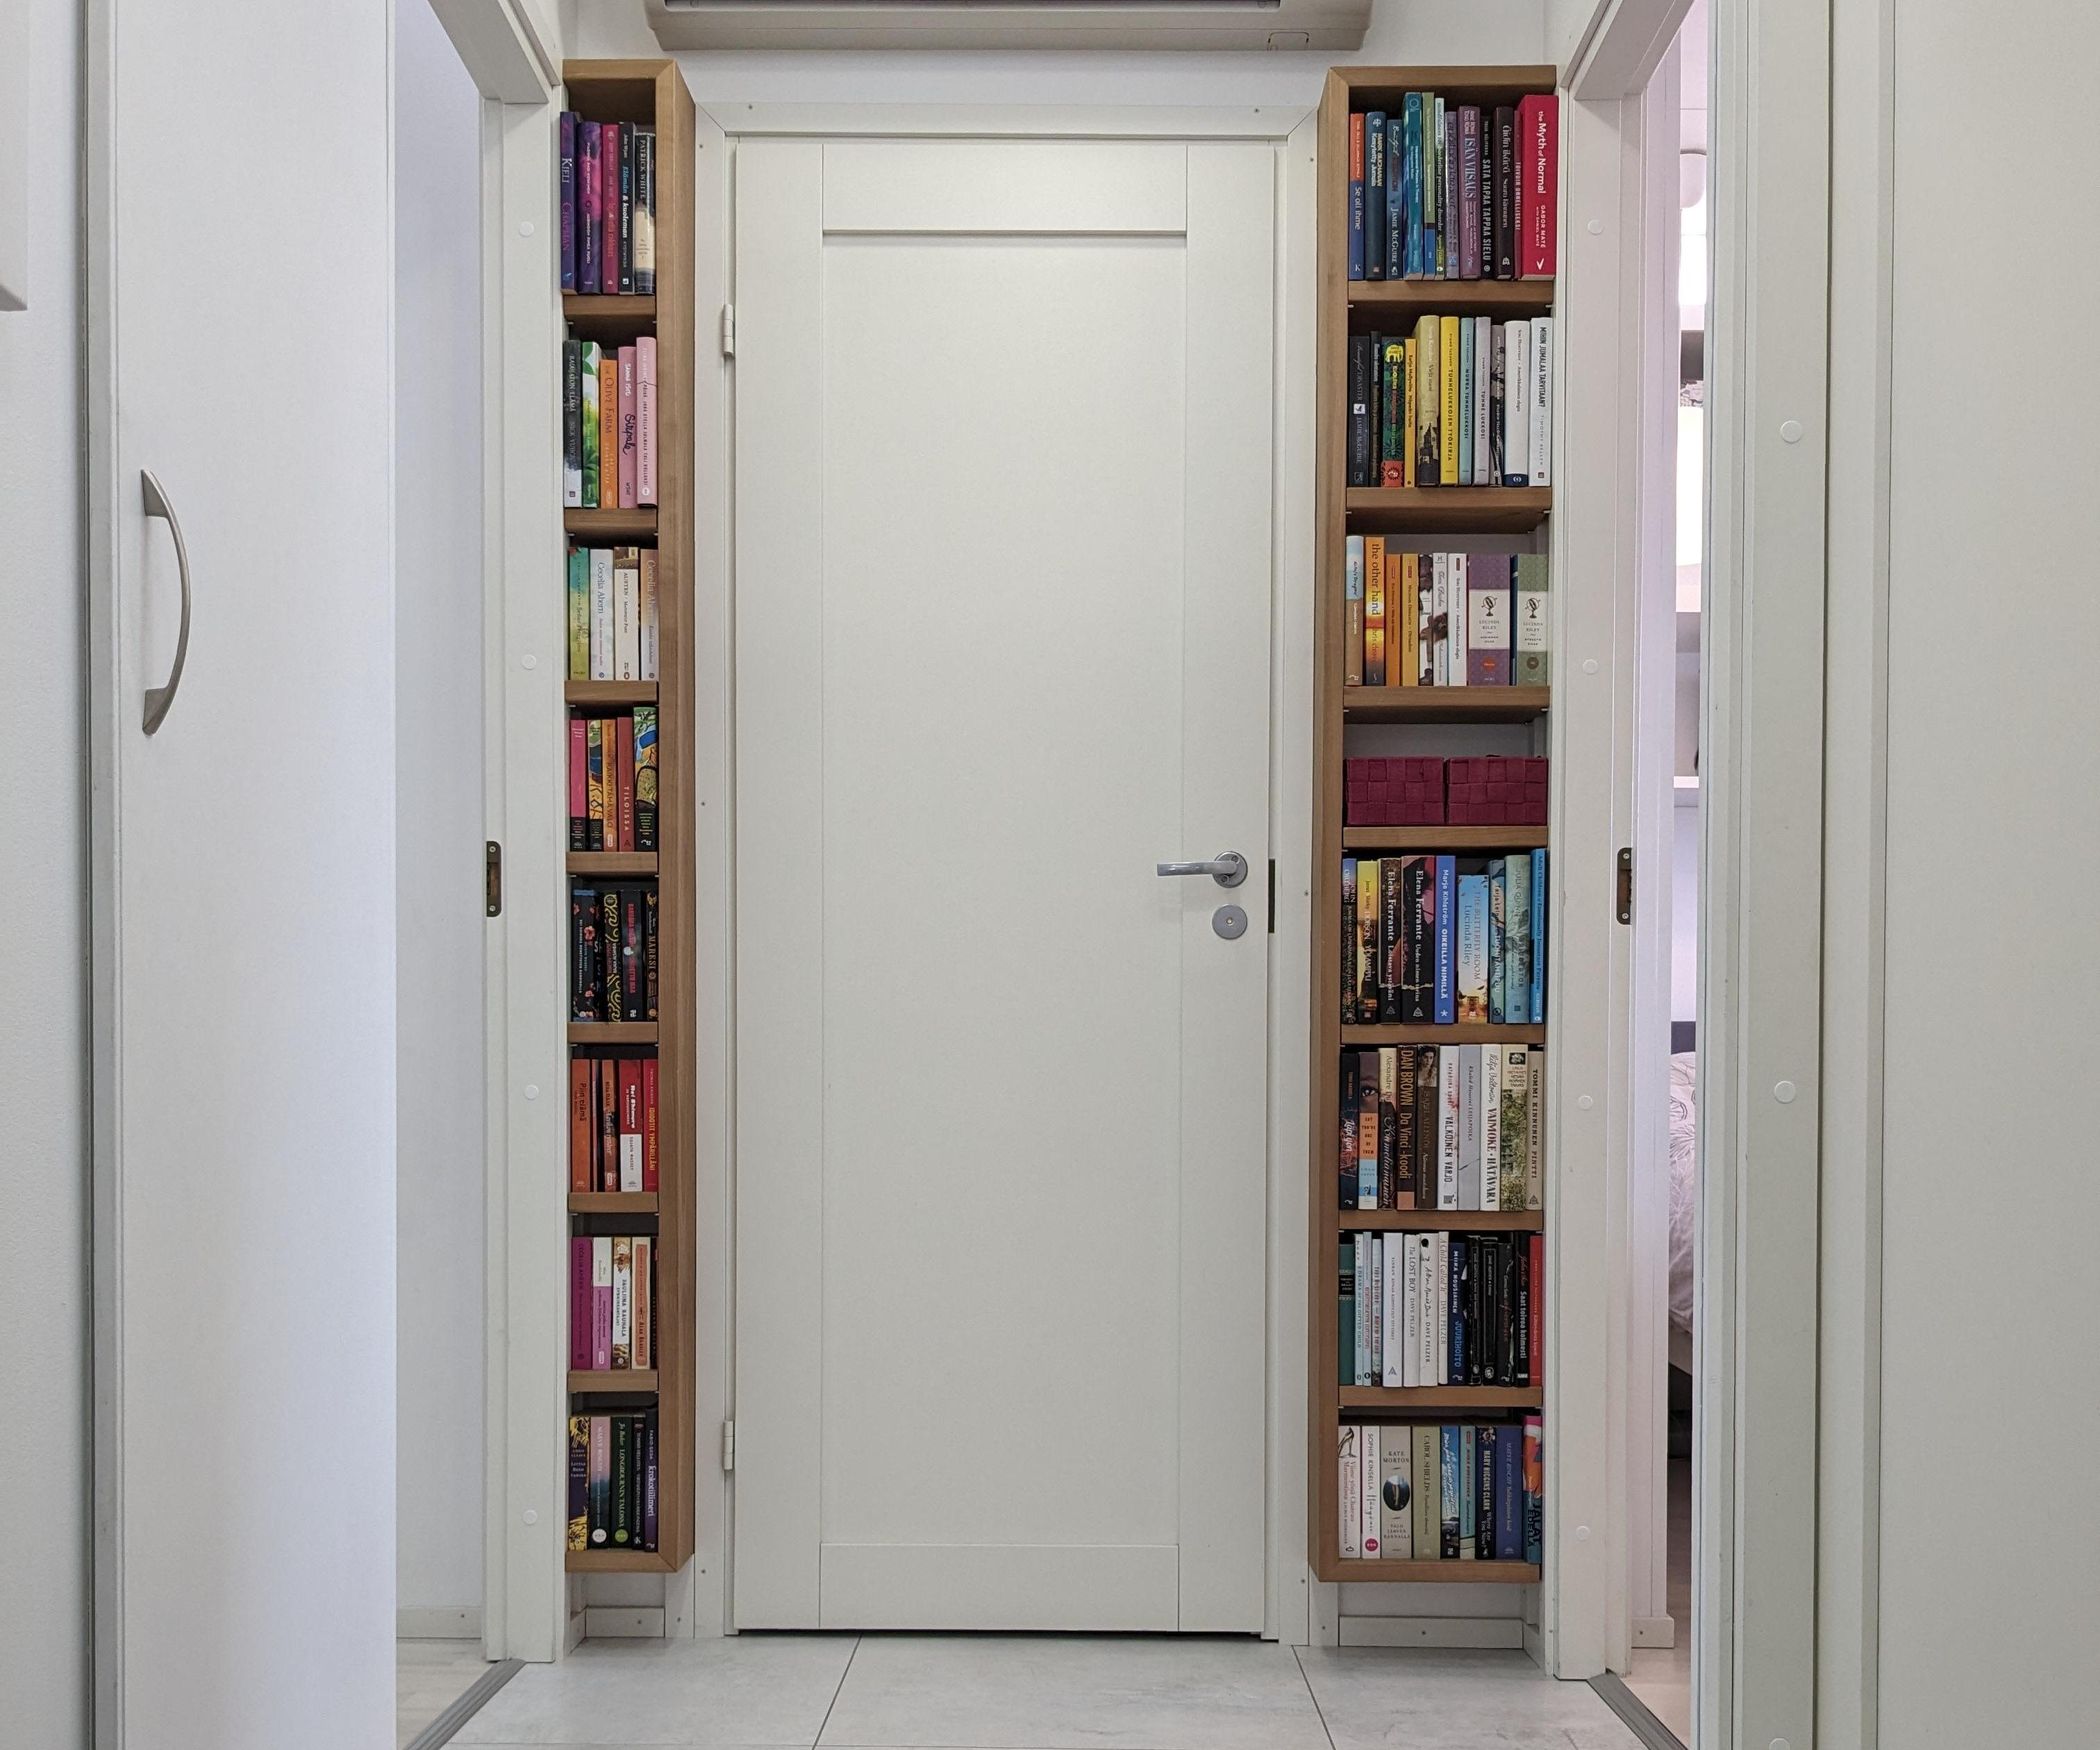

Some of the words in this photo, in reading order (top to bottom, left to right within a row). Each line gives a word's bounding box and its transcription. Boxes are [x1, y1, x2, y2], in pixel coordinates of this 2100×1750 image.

[1536, 122, 1547, 149] Myth
[639, 139, 648, 171] PATRICK
[1464, 137, 1479, 161] ISÄN
[1464, 161, 1476, 199] VIISAUS
[1482, 159, 1491, 179] SATA
[1537, 158, 1547, 194] Normal
[1354, 186, 1362, 197] Se
[1436, 175, 1444, 206] personality
[1482, 181, 1491, 205] TAPAA
[1482, 207, 1491, 236] TAPPAA
[1483, 238, 1491, 261] SIELU
[1538, 374, 1546, 407] TARVITAAN?
[622, 413, 636, 455] Sirpale
[1371, 543, 1381, 560] the
[597, 562, 605, 589] Cecelia
[1371, 561, 1381, 587] other
[597, 591, 605, 614] Ahern
[1371, 590, 1381, 616] hand
[1386, 871, 1395, 896] Elena
[1415, 870, 1424, 895] Elena
[1387, 899, 1396, 941] Ferrante
[1415, 898, 1424, 940] Ferrante
[1463, 905, 1472, 942] Lucinda
[1473, 909, 1481, 952] BUTTERFLY
[648, 935, 656, 969] MARESI
[1462, 943, 1472, 967] Riley
[1473, 954, 1481, 980] ROOM
[1441, 966, 1449, 999] NIMILLÄ
[1385, 1055, 1393, 1090] Alexandre
[1400, 1050, 1413, 1069] DAN
[1400, 1071, 1413, 1105] BROWN
[1400, 1113, 1412, 1125] Da
[1487, 1108, 1497, 1152] VAIMOKE
[1400, 1127, 1412, 1148] Vinci
[1444, 1116, 1453, 1158] VALKOINEN
[1400, 1151, 1413, 1179] -koodi
[1444, 1162, 1453, 1183] VARJO
[1487, 1158, 1498, 1204] HÄTÄVARA
[1408, 1256, 1416, 1276] LOST
[1408, 1278, 1416, 1293] BOY
[1519, 1291, 1527, 1307] Saat
[1519, 1308, 1527, 1329] toivoa
[1454, 1320, 1463, 1368] JUURIHOITO
[1520, 1330, 1528, 1359] kolmesti
[1483, 1450, 1491, 1466] MARY
[647, 1465, 657, 1517] krokotiilimeri
[1482, 1467, 1491, 1490] HIGGINS
[1482, 1492, 1491, 1510] CLARK
